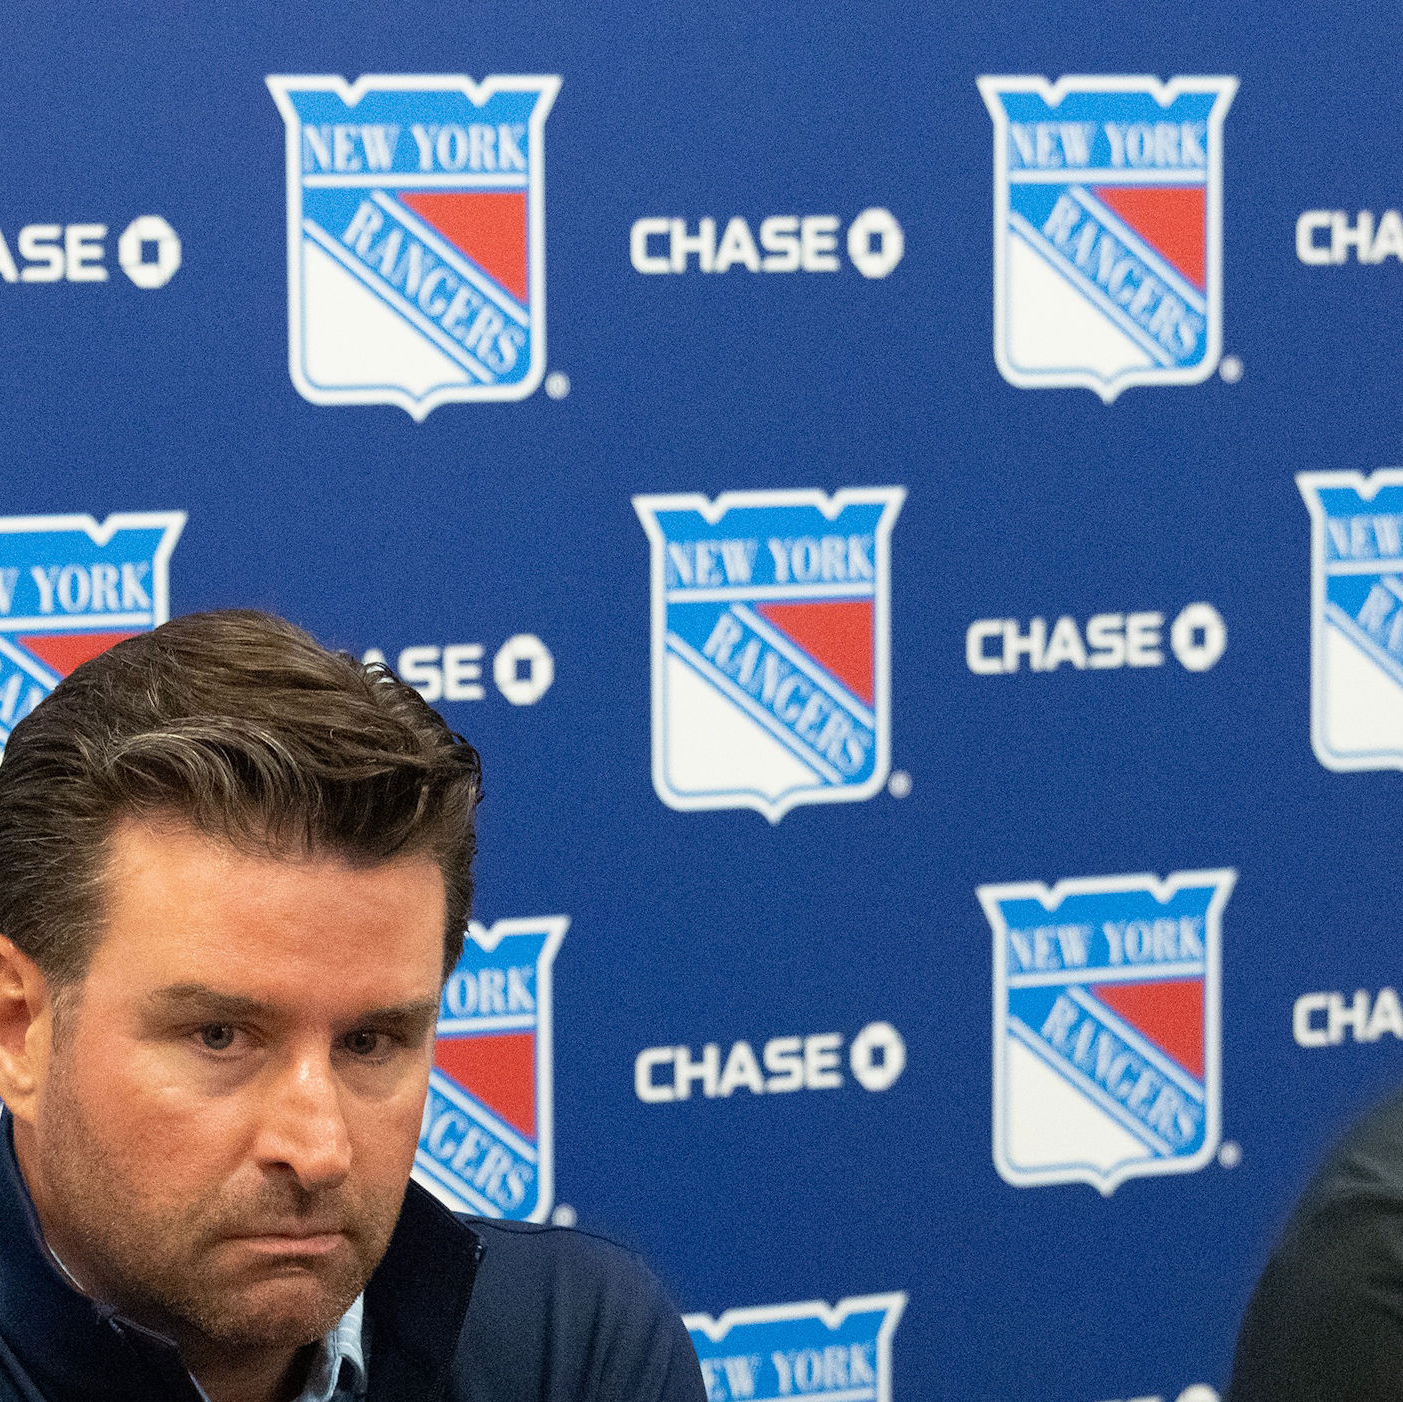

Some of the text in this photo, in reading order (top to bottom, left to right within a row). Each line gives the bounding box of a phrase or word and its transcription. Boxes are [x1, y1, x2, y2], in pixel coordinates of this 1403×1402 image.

[302, 124, 527, 172] NEW YORK
[1008, 122, 1207, 168] NEW YORK
[630, 216, 839, 274] CHASE
[342, 201, 524, 372] RANGERS
[31, 563, 151, 614] YORK
[666, 536, 874, 586] NEW YORK
[966, 612, 1162, 674] CHASE
[703, 613, 871, 773] RANGERS
[1007, 917, 1205, 972] NEW YORK
[446, 966, 535, 1017] ORK
[635, 1034, 841, 1102] CHASE
[1041, 995, 1201, 1146] RANGERS
[771, 1342, 876, 1395] YORK
